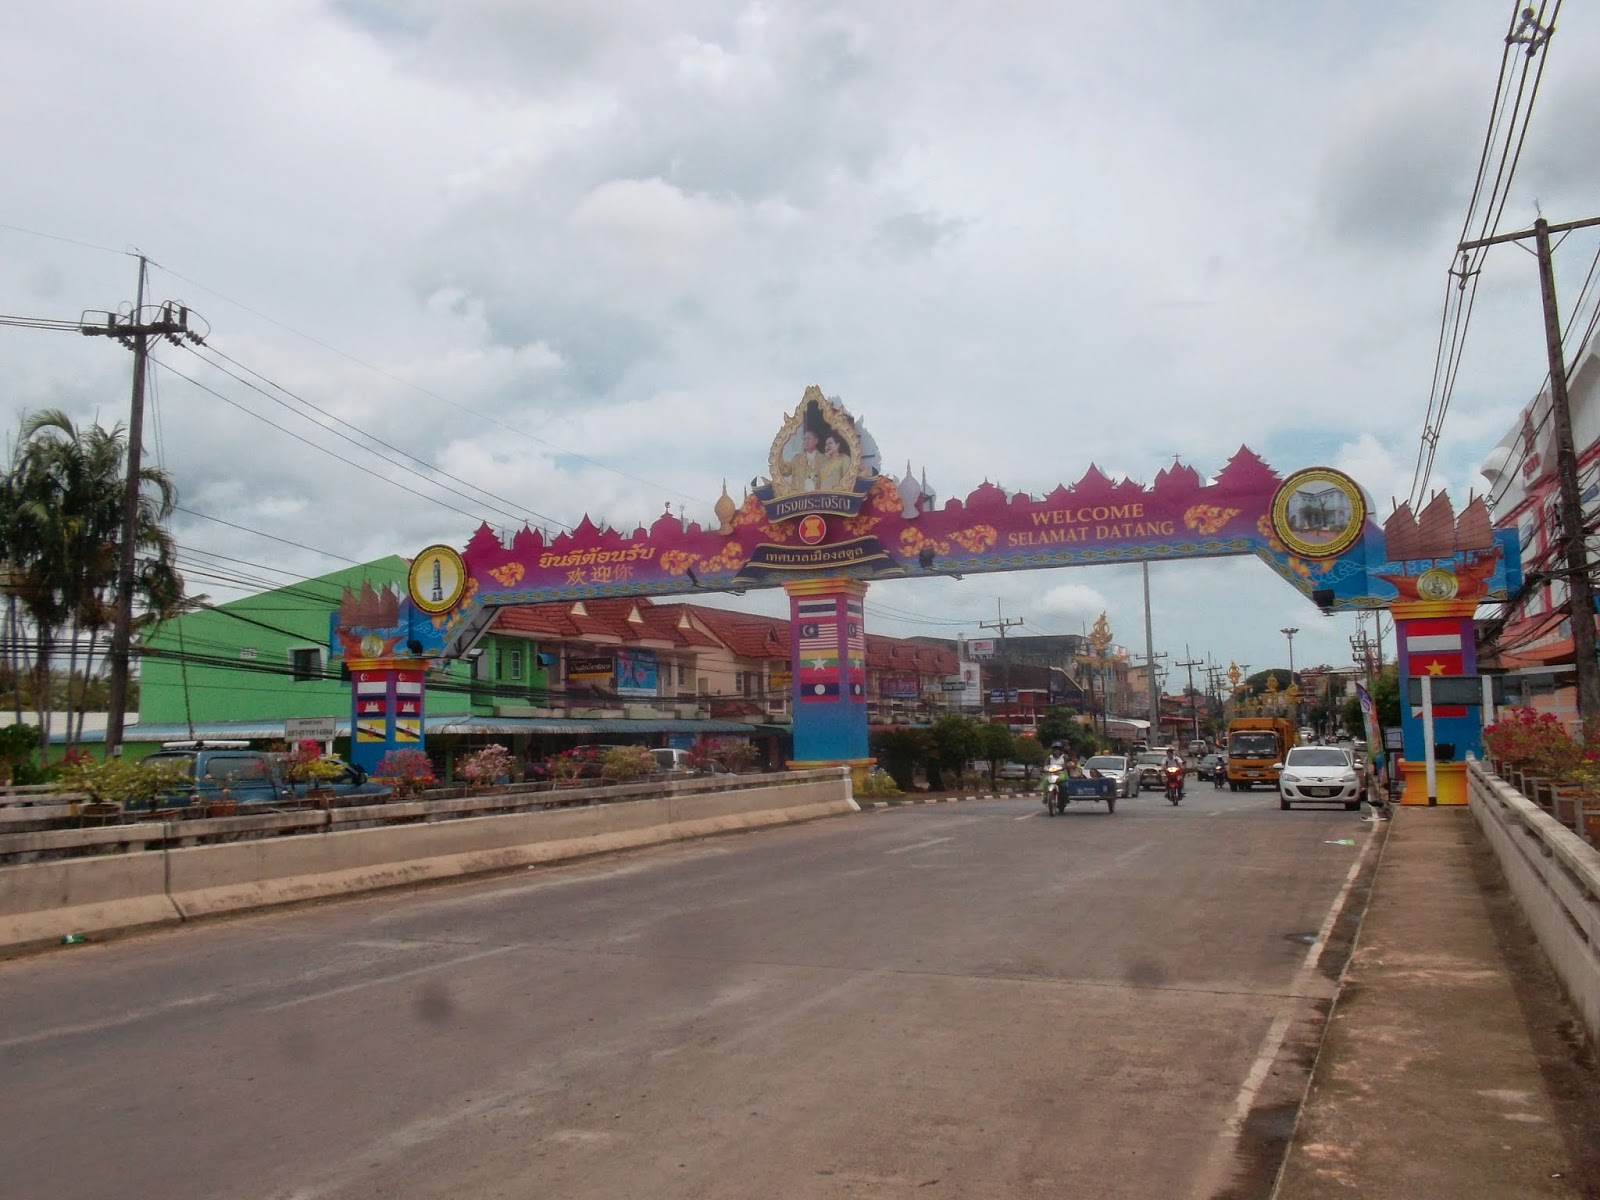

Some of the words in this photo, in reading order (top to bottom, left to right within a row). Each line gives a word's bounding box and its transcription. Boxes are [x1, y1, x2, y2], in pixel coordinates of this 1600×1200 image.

[776, 495, 851, 516] ทรงพระเจริญ
[1031, 503, 1145, 527] WELCOME
[1008, 526, 1089, 547] SELAMAT
[1096, 521, 1175, 541] DATANG
[538, 543, 656, 568] ยินดีต้อนรับ
[766, 546, 863, 563] เทศบาลเมืองสตูล
[565, 564, 634, 586] 欢迎你
